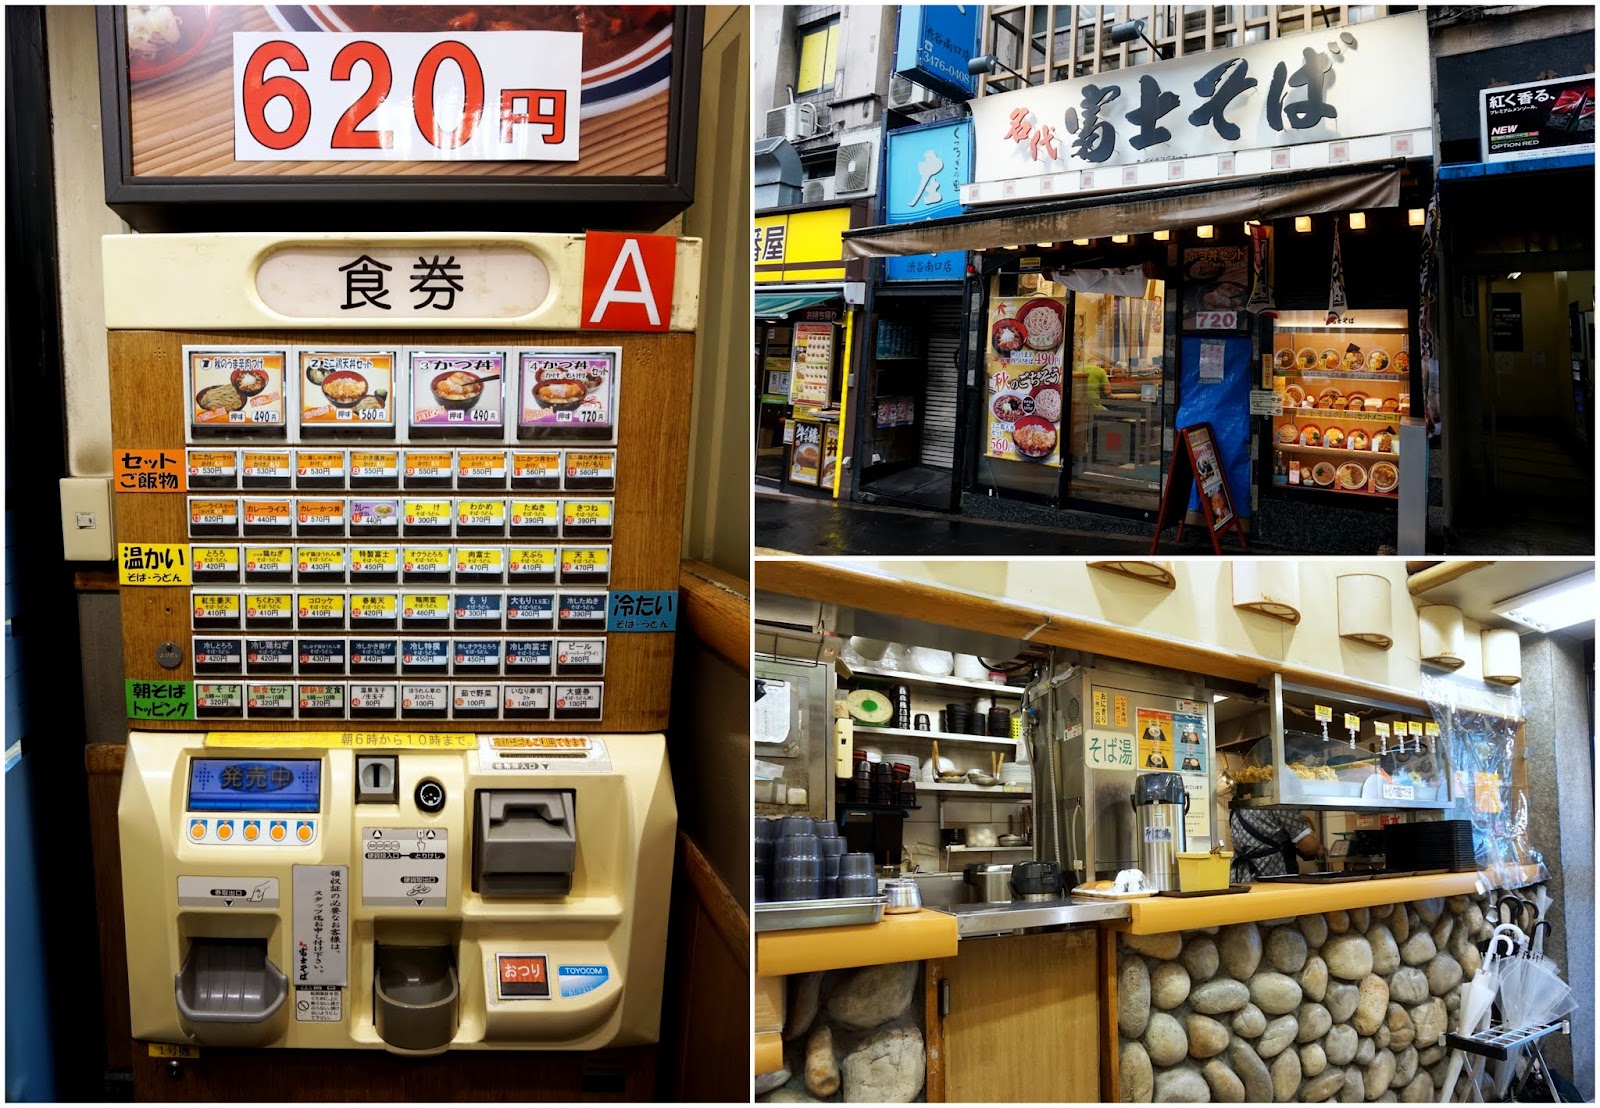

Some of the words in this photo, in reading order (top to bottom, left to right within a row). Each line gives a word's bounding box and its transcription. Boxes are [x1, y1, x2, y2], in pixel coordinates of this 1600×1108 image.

[925, 25, 971, 61] 渋谷南口店
[923, 51, 970, 84] 3476-0408
[242, 40, 567, 149] 620円
[1003, 107, 1059, 162] 名代
[1064, 30, 1358, 163] 富士そば
[1489, 89, 1556, 109] 紅く香る、
[1491, 125, 1518, 135] NEW
[1492, 142, 1520, 150] OPTION
[1187, 250, 1244, 262] かつ丼セット
[906, 260, 952, 273] 渋谷南口店
[338, 254, 464, 311] 食券
[589, 238, 661, 326] A
[1198, 313, 1235, 328] 720
[214, 358, 263, 369] 秋のうま辛肉つけ
[323, 358, 372, 369] ミニ鶏天丼セット
[434, 360, 494, 370] かつ丼
[543, 361, 588, 370] かつ丼
[1035, 352, 1060, 365] 490円
[592, 368, 608, 376] セット
[994, 367, 1060, 391] 秋のごちそう
[254, 411, 276, 422] 490円
[362, 410, 384, 420] 560円
[473, 411, 495, 421] 490円
[582, 411, 603, 422] 720円
[122, 453, 177, 470] セット
[120, 473, 178, 489] ご飯物
[354, 504, 370, 512] カレー
[124, 546, 184, 570] 温かい
[127, 573, 182, 582] そば・うどん
[567, 597, 598, 605] 冷したぬき
[614, 595, 672, 616] 冷たい
[251, 641, 289, 649] 冷し鶏ねぎ
[133, 683, 185, 699] 朝そば
[461, 689, 491, 697] 茹で野菜
[134, 701, 188, 717] トッピング
[1089, 737, 1133, 765] そば湯
[221, 766, 292, 788] 発売中
[330, 870, 341, 953] 領収証の必要なお客様は、
[299, 949, 308, 980] 富士そば
[504, 963, 540, 978] おつり
